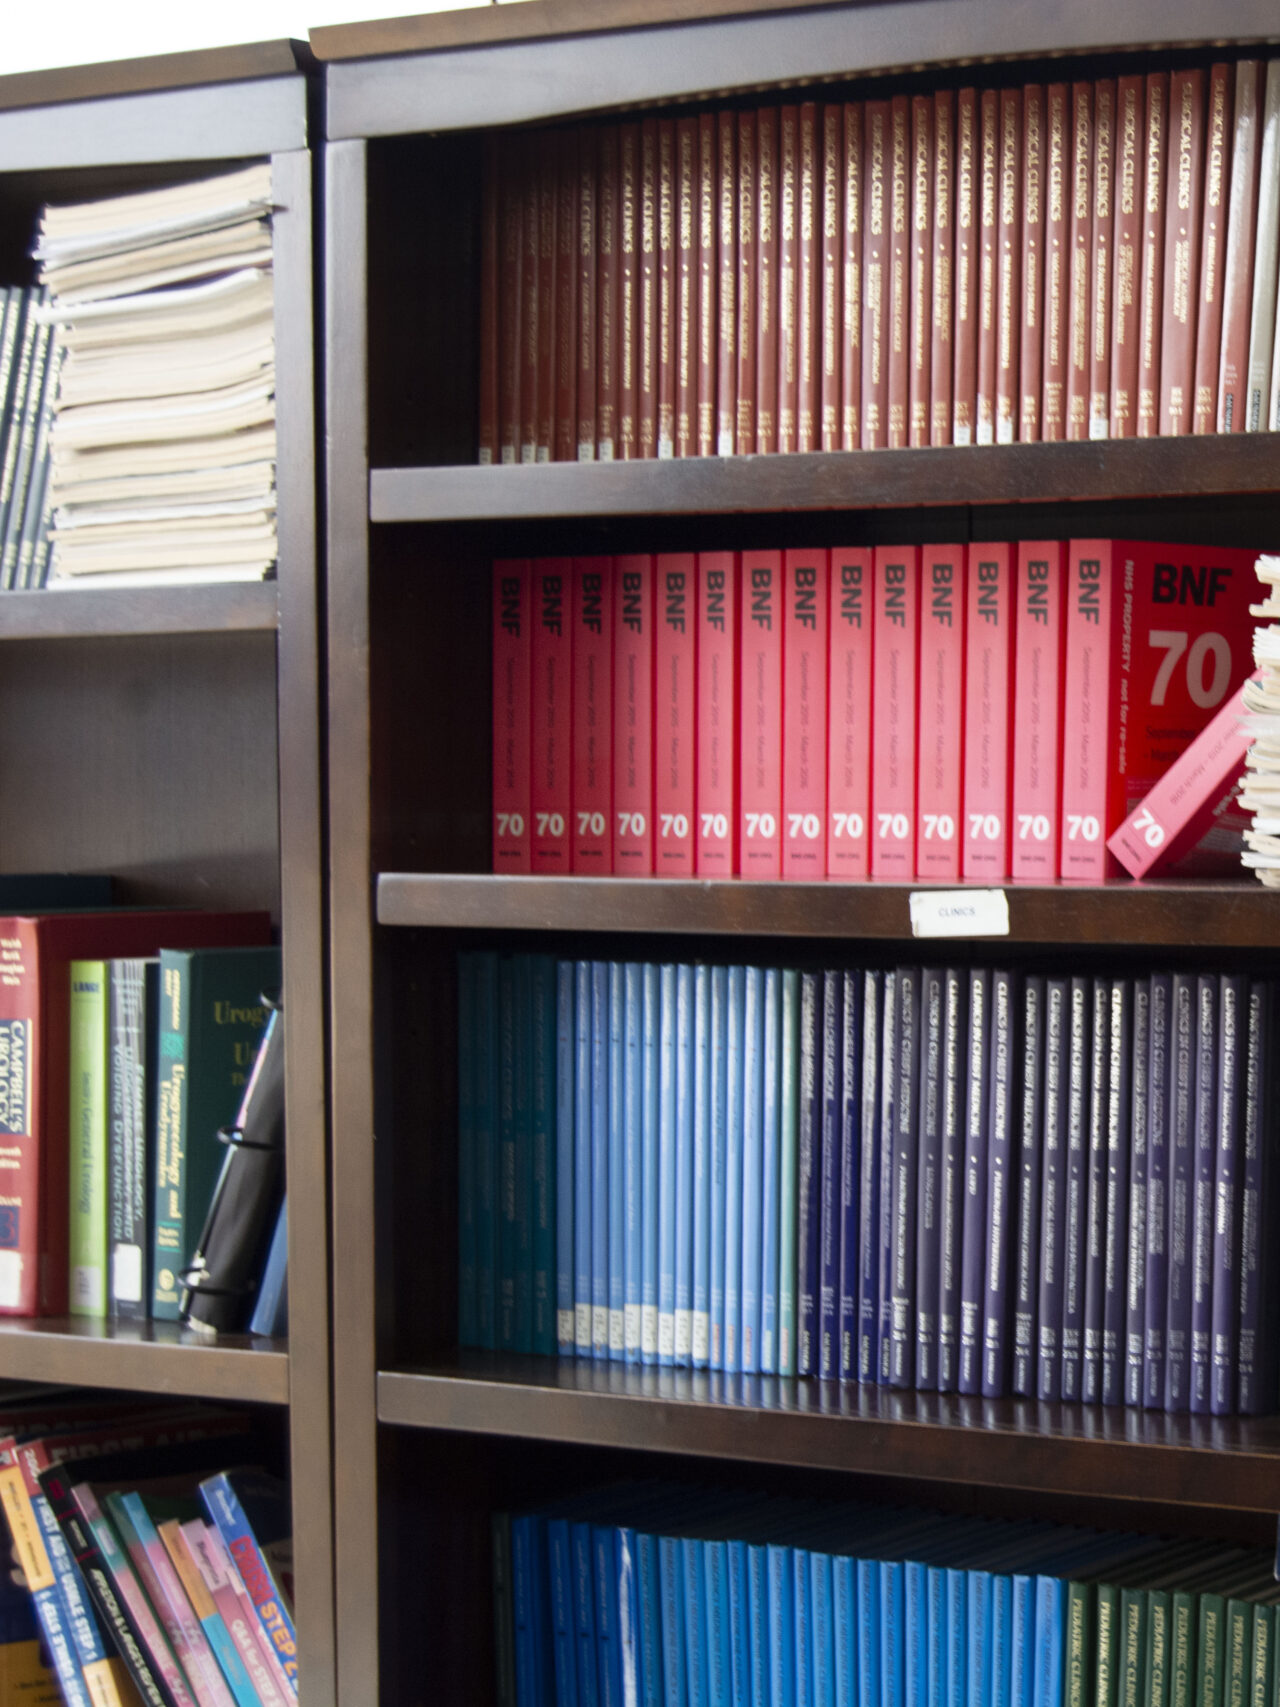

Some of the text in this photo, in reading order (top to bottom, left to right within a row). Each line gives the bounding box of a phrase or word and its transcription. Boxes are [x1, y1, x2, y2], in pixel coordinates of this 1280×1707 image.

[501, 578, 520, 638] BNF
[542, 576, 562, 637] BNF
[582, 573, 602, 635] BNF
[623, 572, 642, 635] BNF
[666, 572, 686, 634] BNF
[707, 570, 725, 633] BNF
[752, 569, 772, 631] BNF
[795, 567, 816, 630] BNF
[841, 565, 862, 629] BNF
[885, 564, 905, 628] BNF
[933, 563, 953, 628] BNF
[978, 561, 999, 626] BNF
[1027, 560, 1049, 625] BNF
[1078, 559, 1100, 624] BNF
[1151, 563, 1233, 608] BNF
[1148, 629, 1232, 709] 70
[496, 813, 525, 836] 70
[536, 813, 565, 837] 70
[577, 812, 605, 837] 70
[618, 812, 646, 836] 70
[660, 814, 688, 838] 70
[701, 813, 728, 838] 70
[745, 813, 776, 838] 70
[787, 813, 820, 839] 70
[832, 813, 864, 839] 70
[877, 813, 909, 839] 70
[922, 814, 955, 840] 70
[968, 814, 1000, 840] 70
[1017, 814, 1050, 840] 70
[1066, 814, 1100, 842] 70
[1133, 807, 1165, 848] 70
[9, 1020, 25, 1133] CAMPBELL'S
[168, 1064, 185, 1219] Urogynecology and
[112, 1119, 123, 1239] DYSFUNCTION
[73, 1614, 96, 1652] STEP
[260, 1601, 298, 1657] STEP
